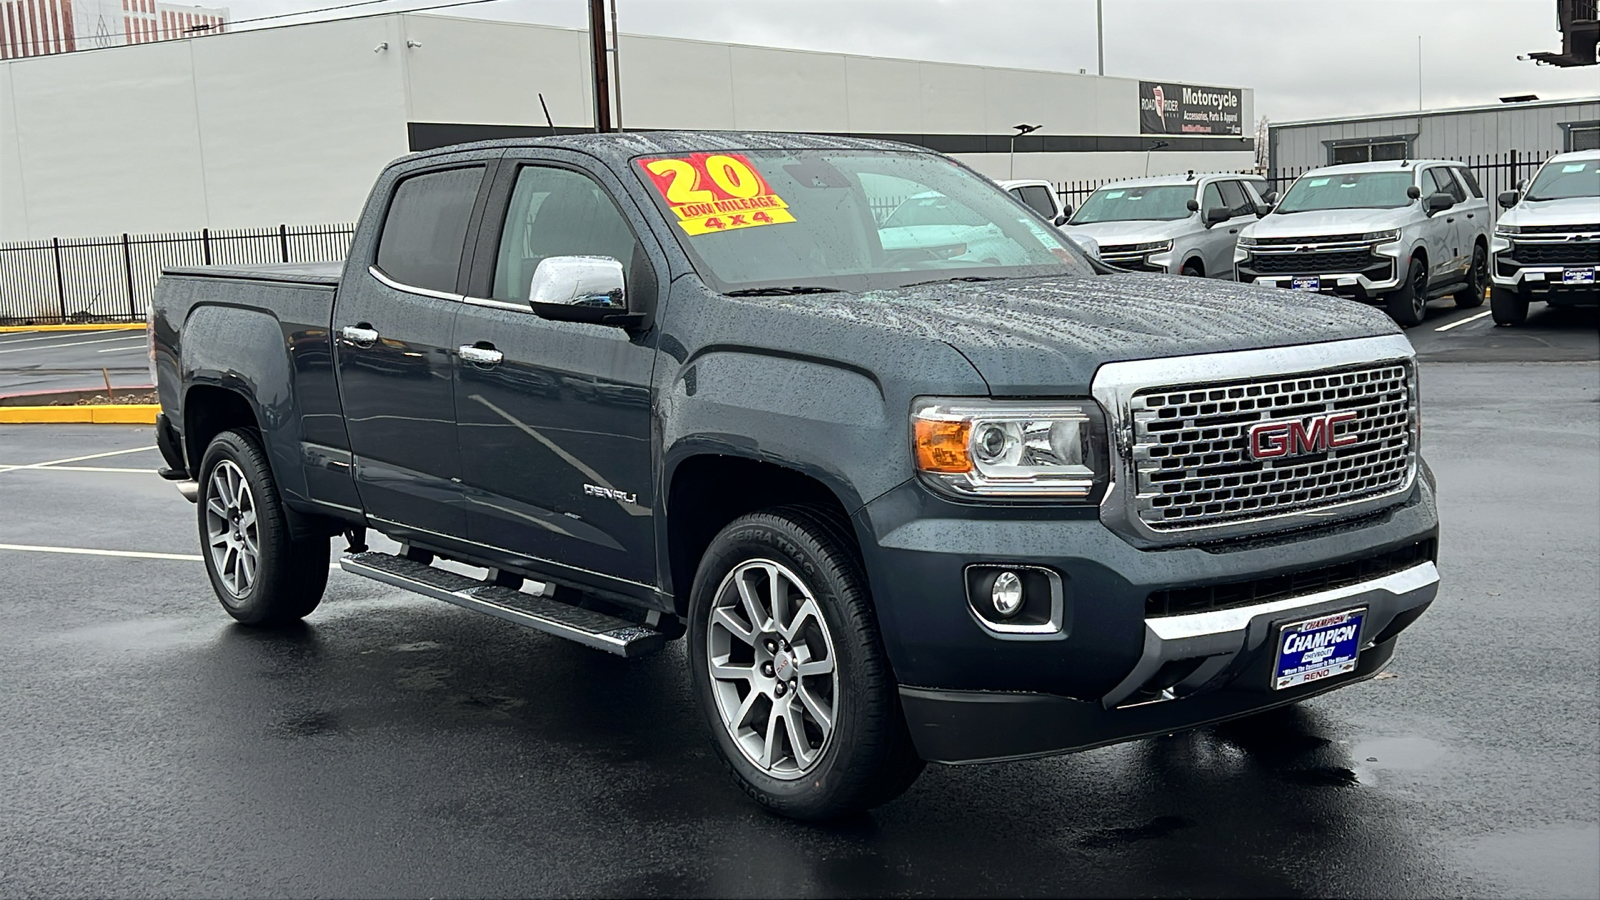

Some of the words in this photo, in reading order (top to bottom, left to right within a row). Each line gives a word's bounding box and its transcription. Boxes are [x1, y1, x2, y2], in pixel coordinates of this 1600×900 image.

[1141, 98, 1156, 111] ROAD
[1164, 99, 1179, 112] RIDER
[1182, 88, 1237, 110] Motorcycle
[1209, 111, 1219, 121] Parts
[647, 155, 764, 204] 20
[679, 203, 715, 219] LOW
[716, 196, 780, 214] MILEAGE
[1249, 411, 1358, 459] GMC
[583, 483, 638, 505] DENALI
[726, 528, 773, 544] TERRA
[776, 536, 815, 574] TRAC
[1305, 615, 1345, 631] CHAMPION
[1283, 624, 1357, 654] CHAMPION
[1304, 648, 1333, 660] CHEVROLET
[1303, 669, 1330, 682] RENO
